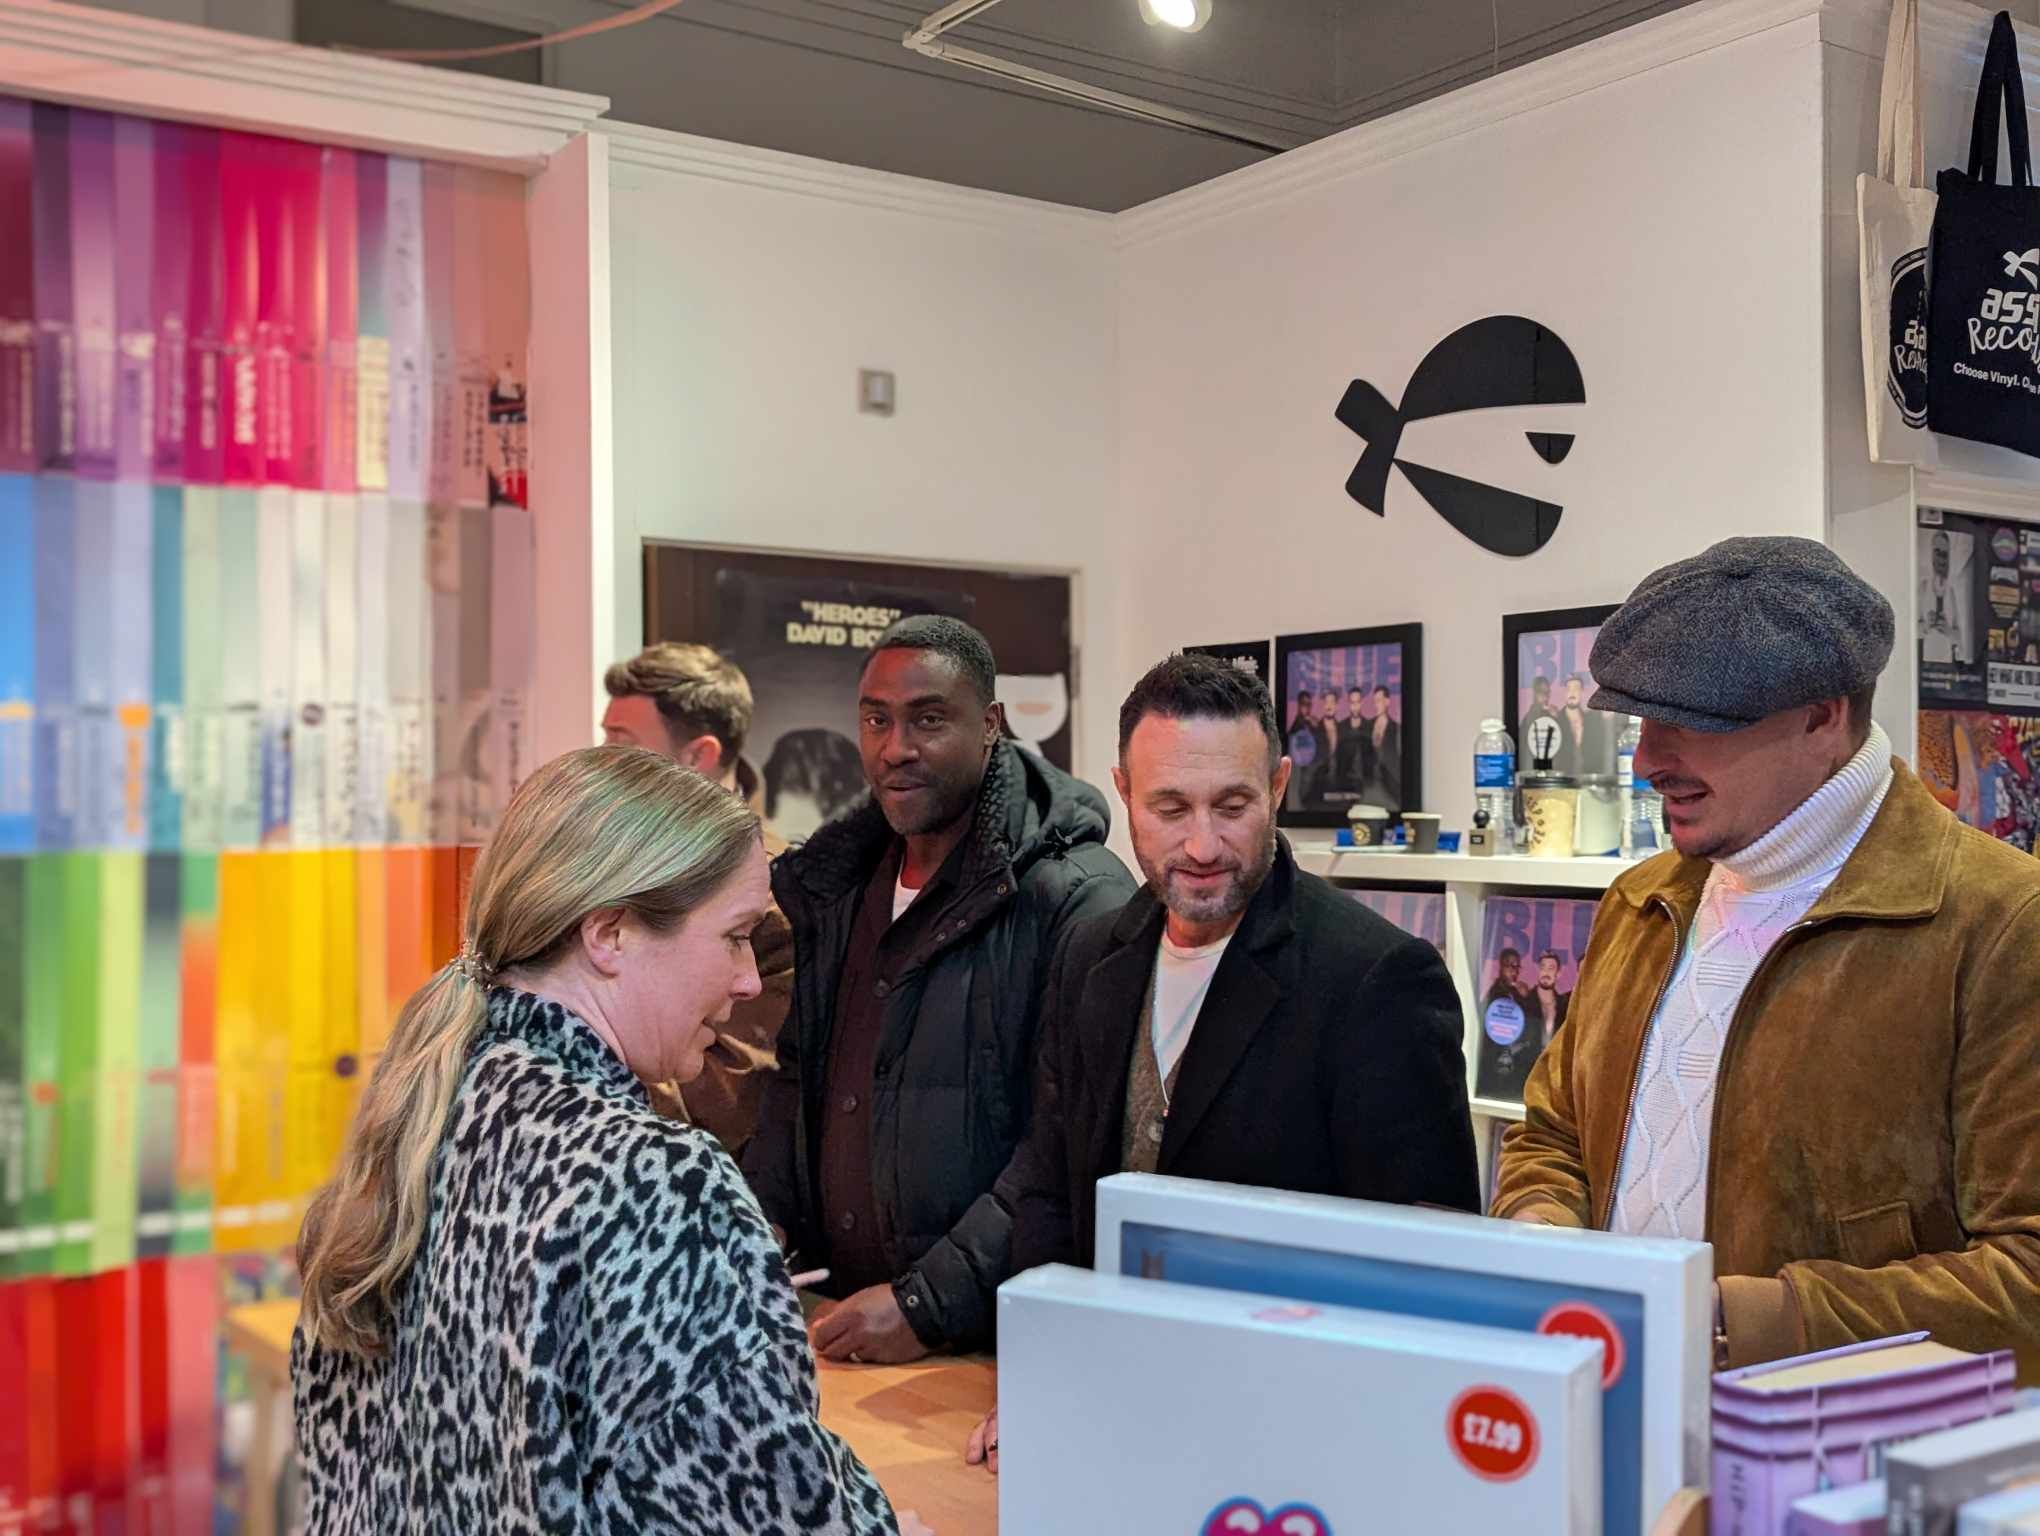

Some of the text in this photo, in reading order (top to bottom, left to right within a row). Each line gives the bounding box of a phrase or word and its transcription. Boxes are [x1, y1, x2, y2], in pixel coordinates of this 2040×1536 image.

[1953, 361, 1989, 381] Choose
[1990, 370, 2020, 388] Vinyl.
[801, 600, 901, 627] "HEROES"
[786, 621, 848, 646] DAVID
[1463, 1412, 1523, 1453] £7.99
